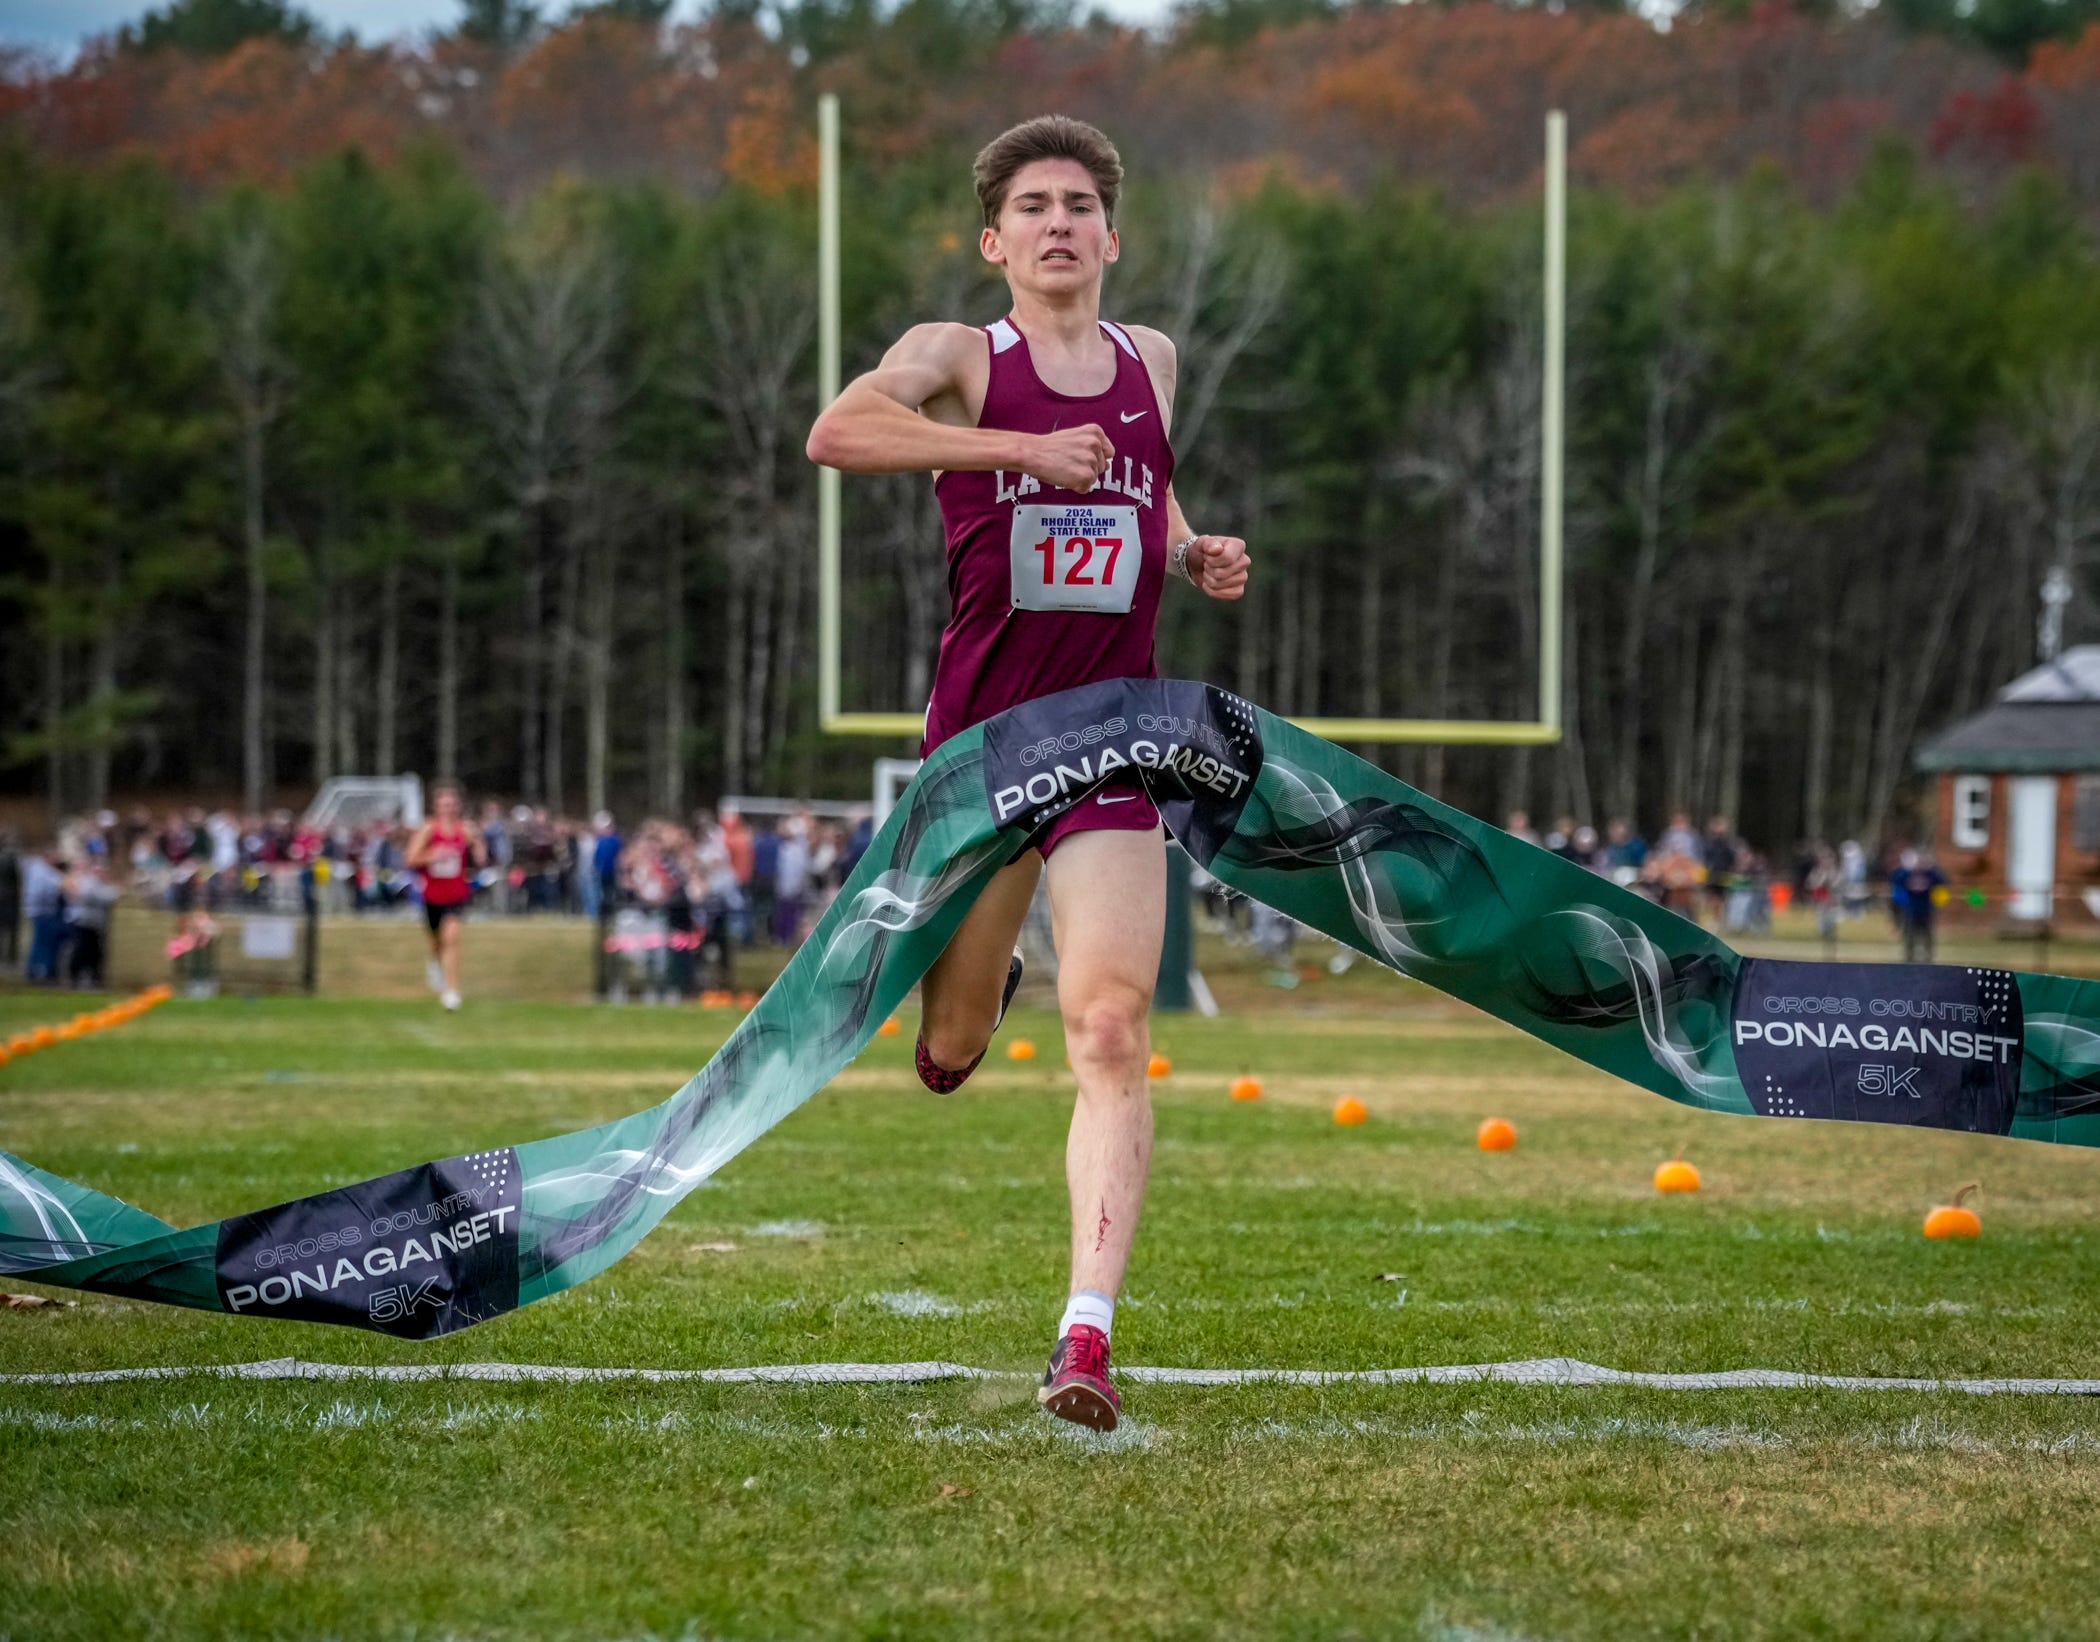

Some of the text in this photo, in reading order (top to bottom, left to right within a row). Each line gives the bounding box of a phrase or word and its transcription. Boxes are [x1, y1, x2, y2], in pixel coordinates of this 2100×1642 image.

[1055, 456, 1153, 509] LLE
[1041, 517, 1116, 527] RHODE ISLAND
[1049, 527, 1109, 536] STATE MEET
[1065, 508, 1093, 518] 2024
[1035, 537, 1123, 585] 127
[1019, 714, 1236, 767] CROSS COUNTRY
[994, 740, 1250, 820] PONAGANSET
[1763, 996, 1995, 1025] CROSS COUNTRY
[1735, 1020, 2018, 1064] PONAGANSET
[1857, 1063, 1921, 1098] 5K
[255, 1184, 491, 1269] CROSS COUNTRY
[226, 1205, 516, 1312] PONAGANSET
[369, 1275, 446, 1323] 5K
